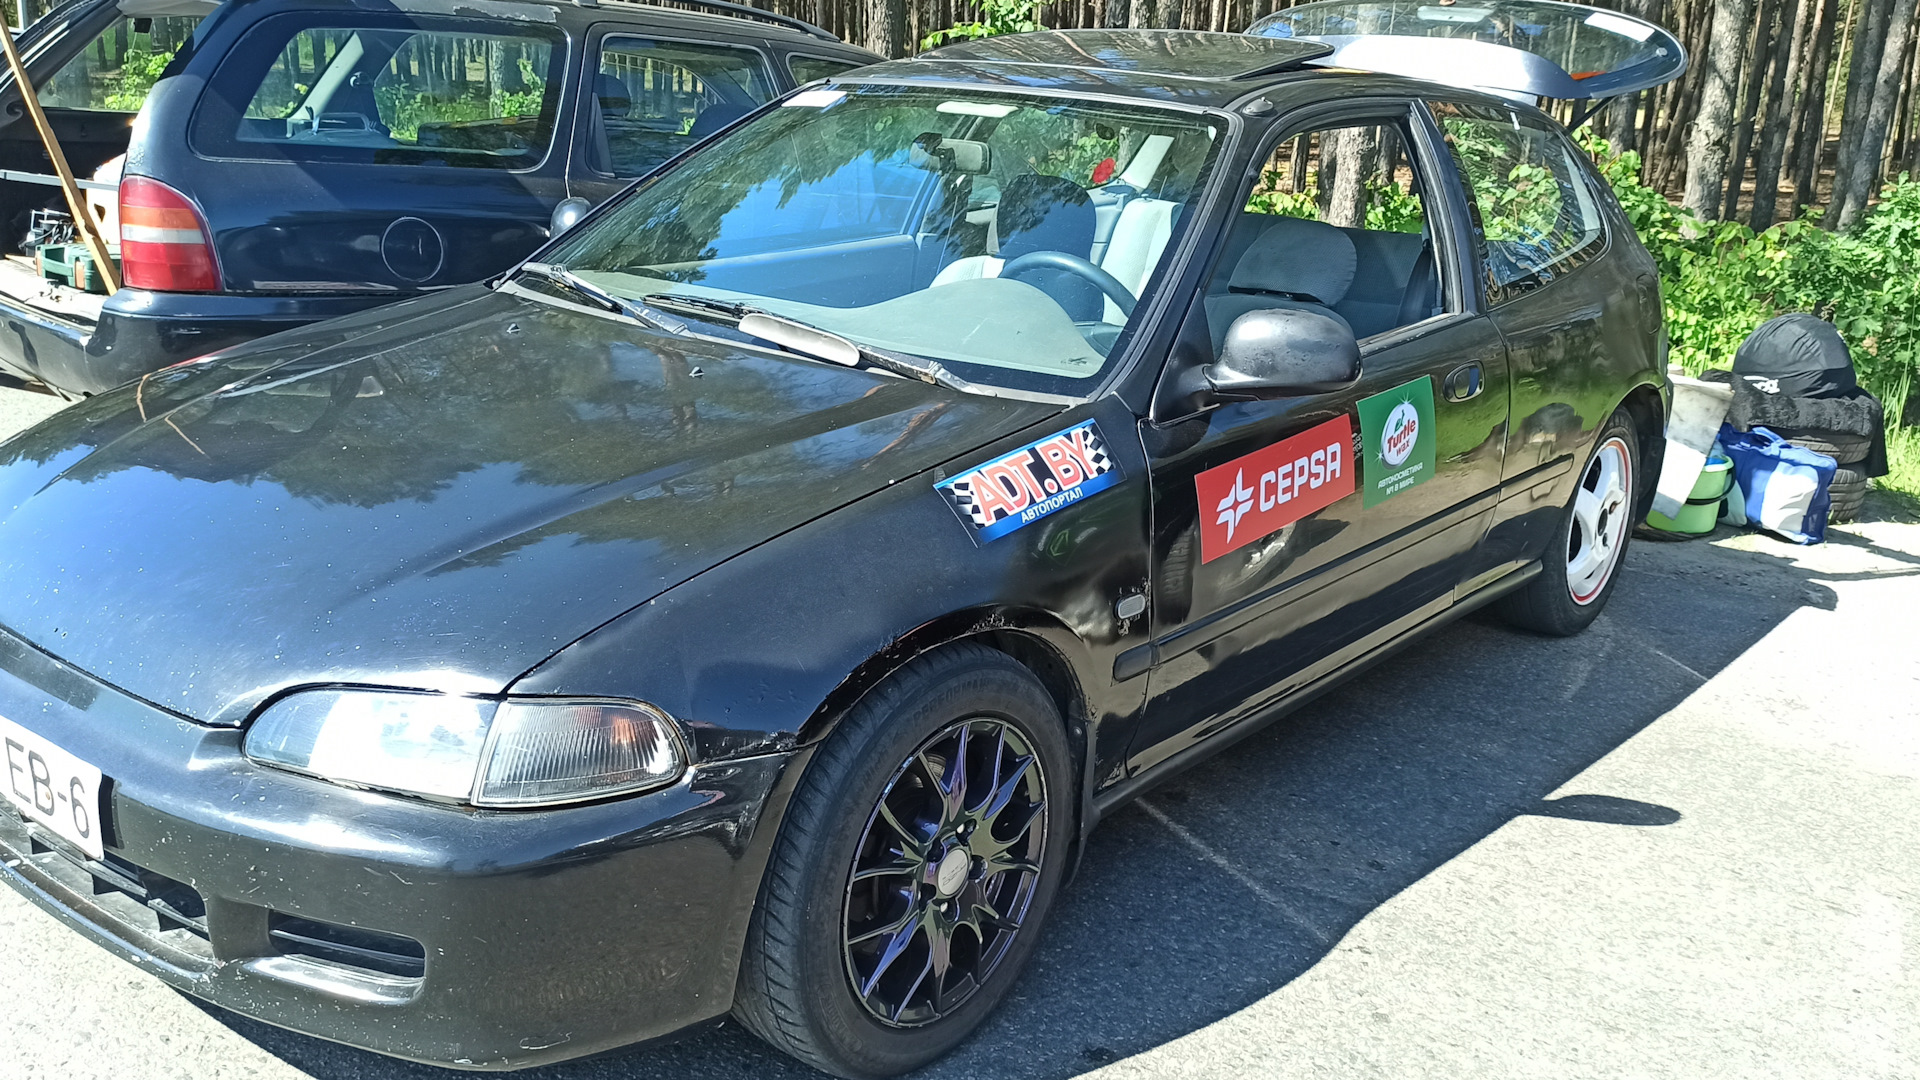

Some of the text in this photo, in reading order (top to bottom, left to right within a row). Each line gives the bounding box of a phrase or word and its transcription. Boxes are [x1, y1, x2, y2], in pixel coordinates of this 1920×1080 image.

[1387, 418, 1416, 453] Turtle
[969, 429, 1097, 525] ADT.BY
[1259, 441, 1341, 513] CEPSA
[1378, 462, 1423, 489] АВТОКОСМЕТИКА
[1021, 486, 1084, 523] АВТОПОРТАЛ
[5, 736, 90, 839] EB-6
